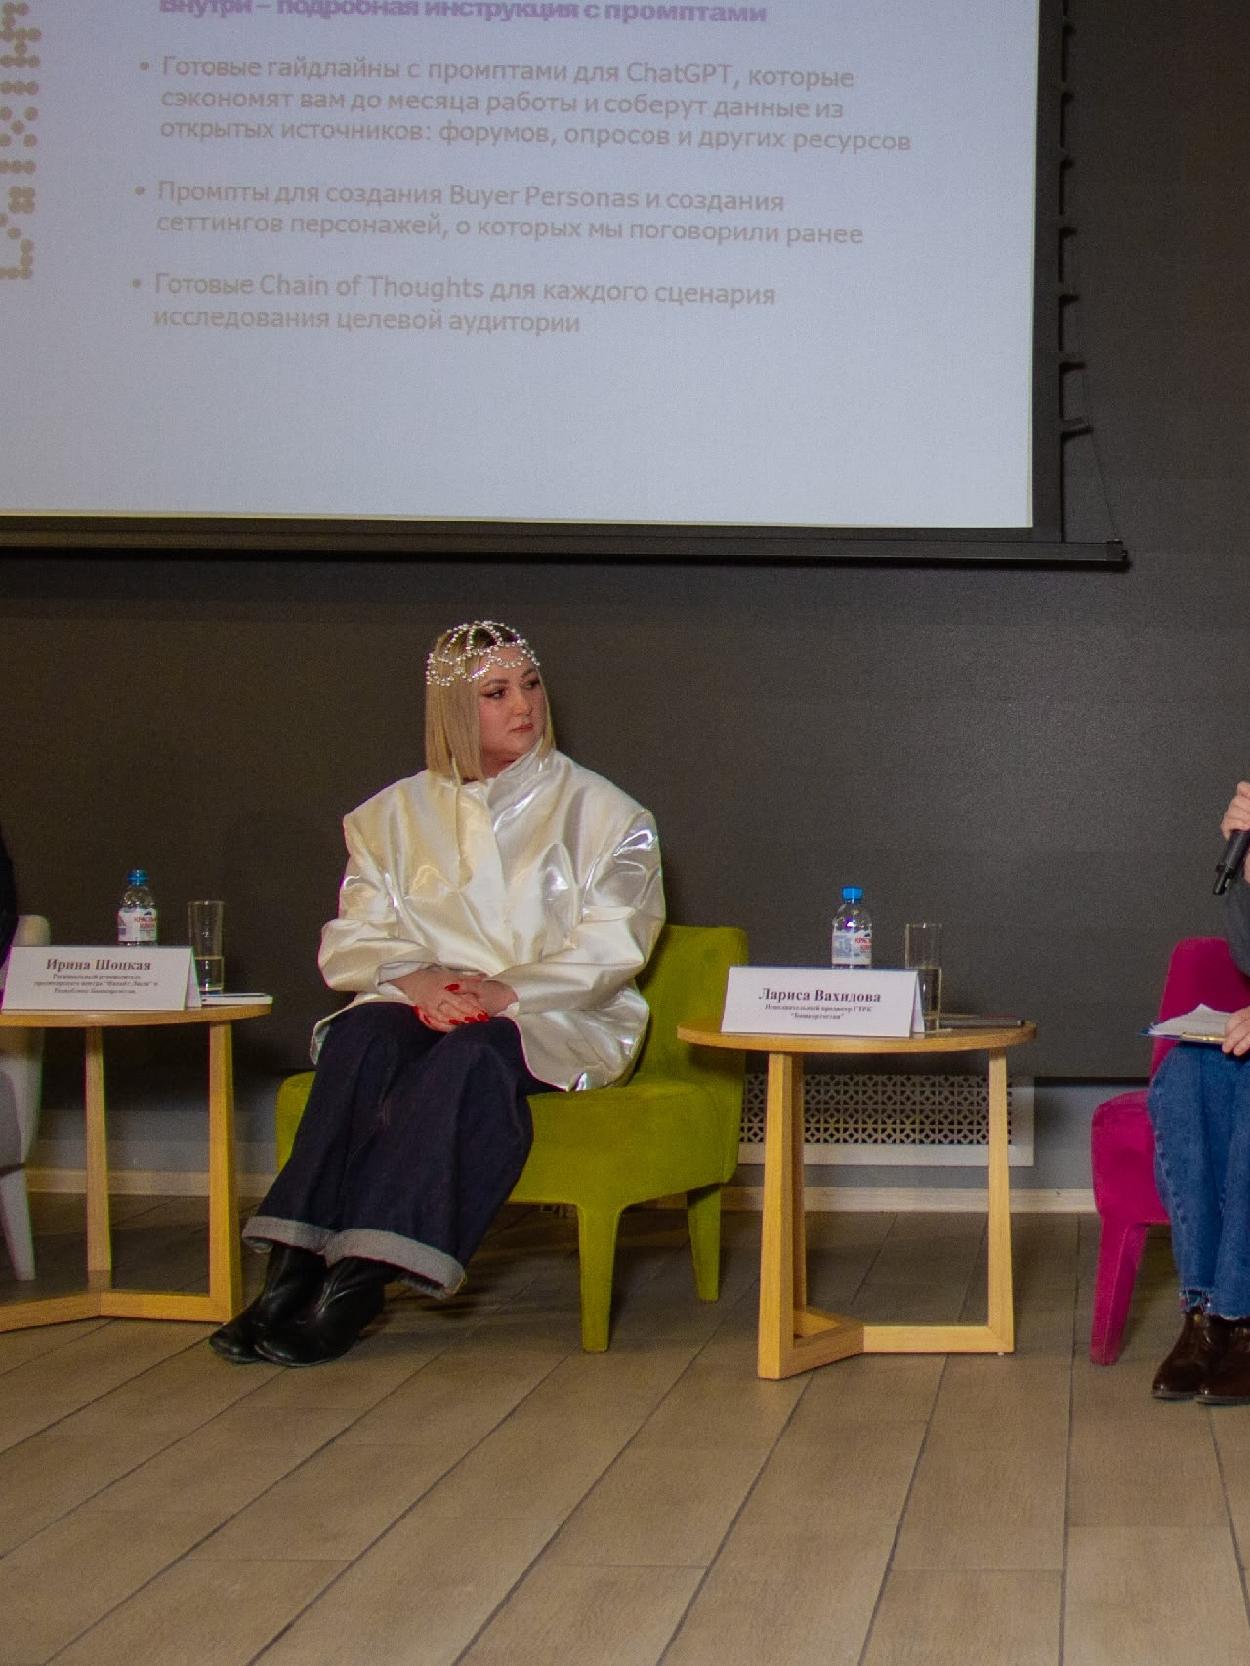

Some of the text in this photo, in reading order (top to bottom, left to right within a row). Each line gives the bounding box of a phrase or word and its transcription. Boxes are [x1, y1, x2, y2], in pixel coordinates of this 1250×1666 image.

[277, 0, 418, 20] подробная
[425, 1, 577, 21] инструкция
[584, 5, 598, 19] с
[604, 5, 767, 23] промптами
[162, 56, 855, 91] Готовые гайдлайны с промптами для ChatGPT, которые
[160, 90, 843, 119] сэкономят вам до месяца работы и соберут данные из
[160, 121, 912, 153] открытых источников: форумов, опросов и других ресурсов
[158, 181, 784, 213] Промпты для создания Buyer Personas и создания
[156, 213, 864, 247] сеттингов персонажей, о которых мы поговорили ранее
[153, 273, 776, 308] Готовые Chain of Thoughts для каждого сценария
[153, 308, 580, 336] исследования целевой аудитории
[46, 958, 91, 973] Ирина
[758, 987, 811, 1003] Лариса
